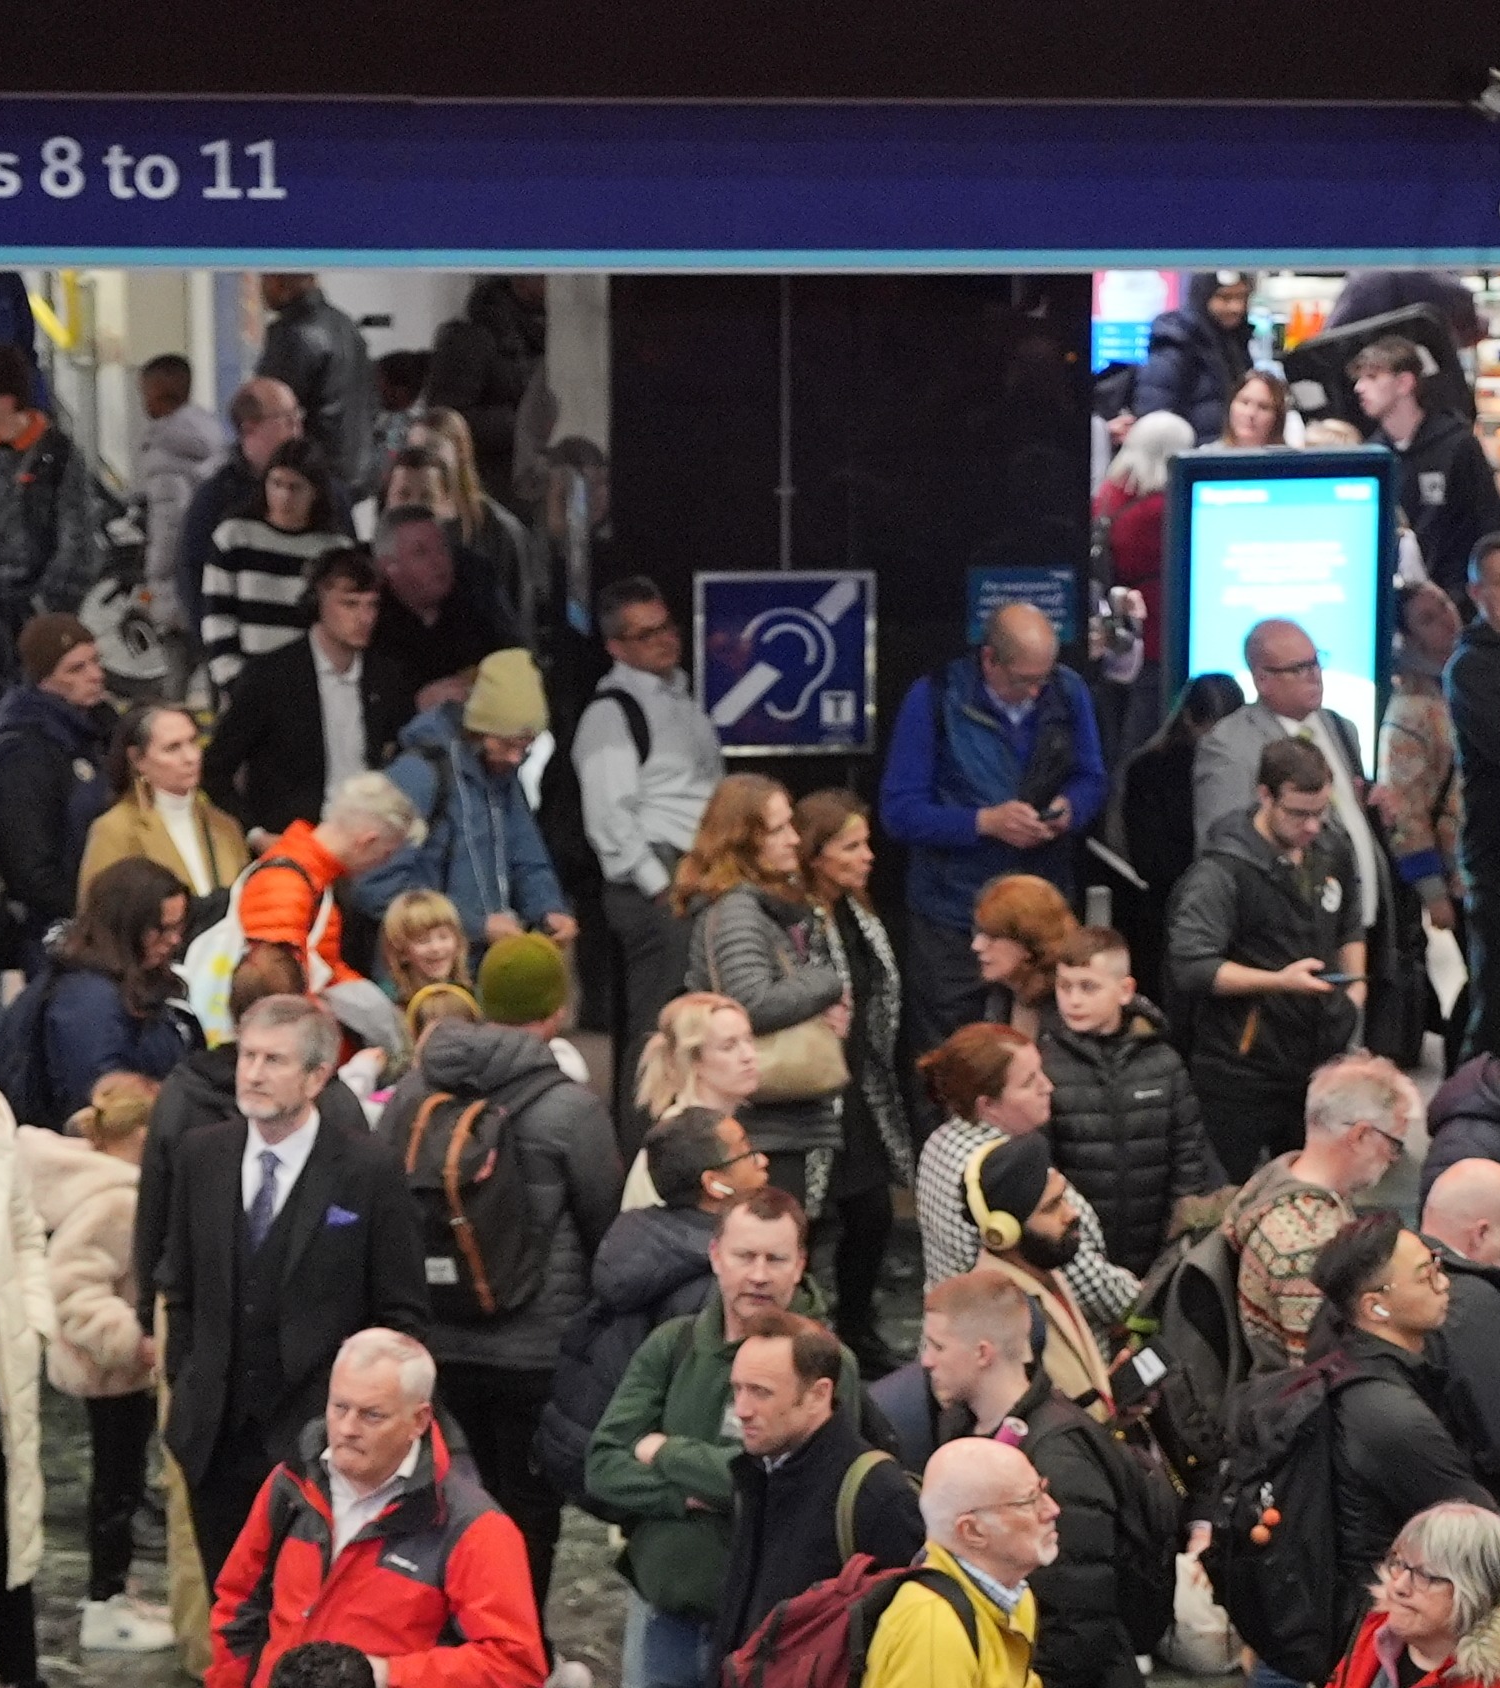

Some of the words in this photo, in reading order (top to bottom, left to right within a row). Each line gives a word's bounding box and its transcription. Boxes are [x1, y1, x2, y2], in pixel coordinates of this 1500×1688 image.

[39, 135, 86, 200] 8
[101, 144, 180, 201] to
[199, 139, 288, 201] 11
